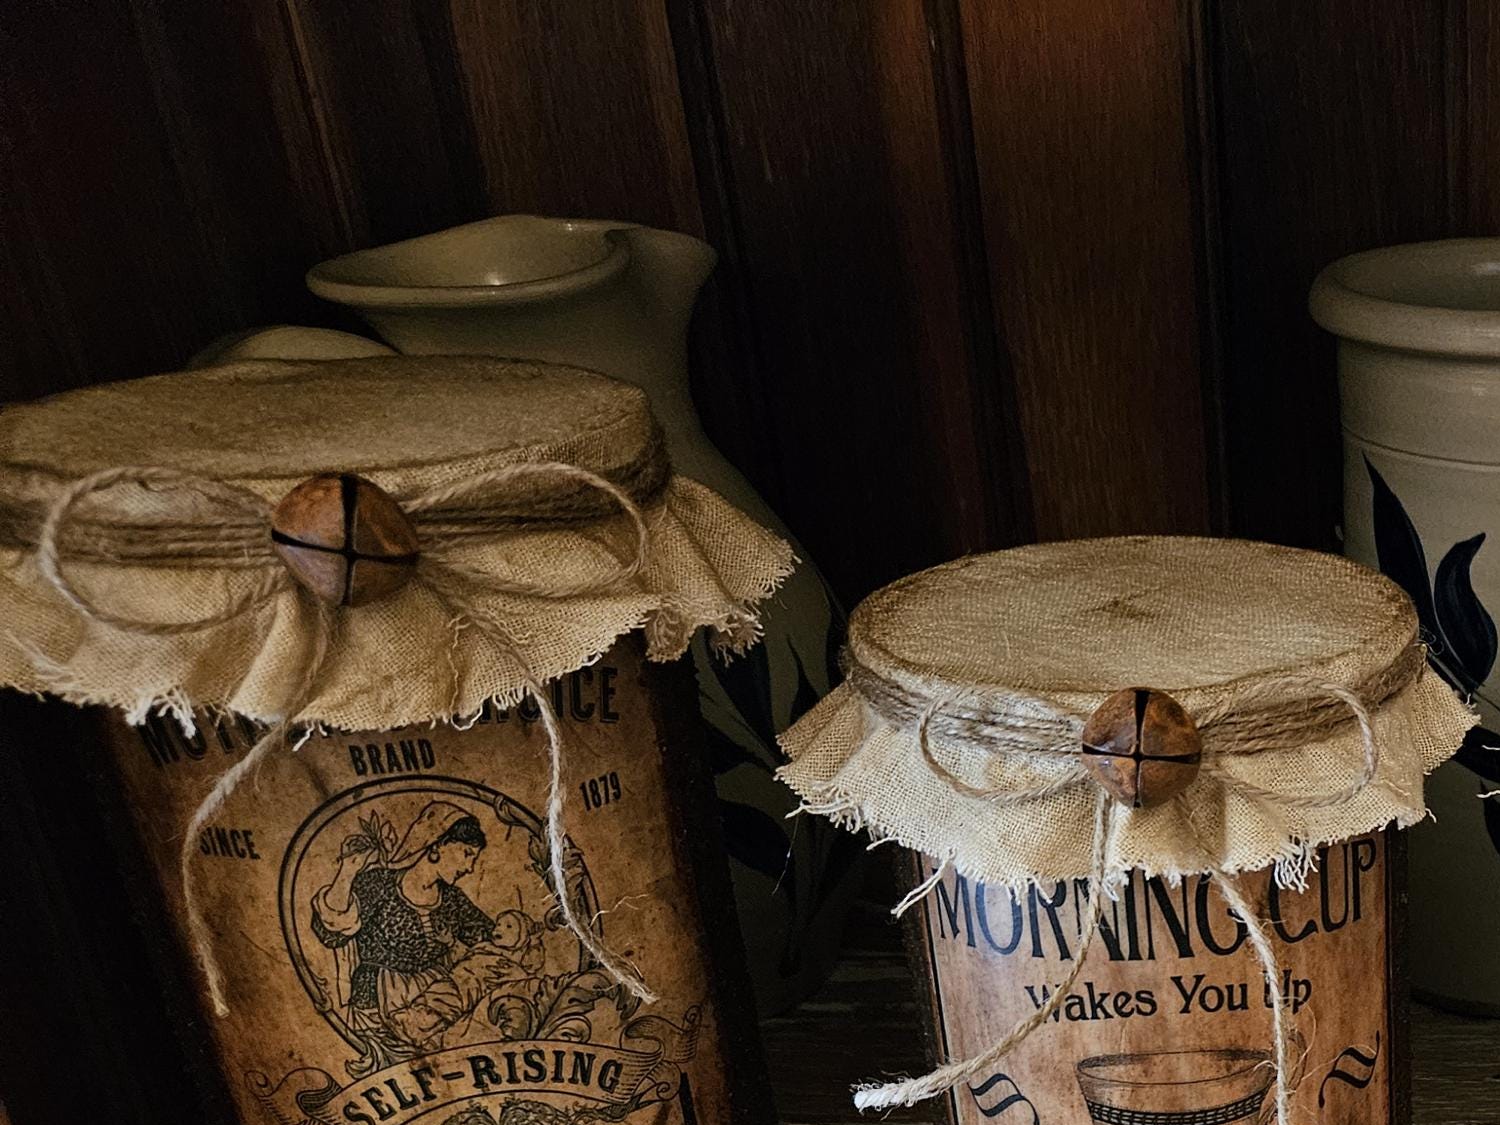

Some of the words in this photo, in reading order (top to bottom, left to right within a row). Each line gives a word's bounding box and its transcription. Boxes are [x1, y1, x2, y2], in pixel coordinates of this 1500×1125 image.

[349, 738, 436, 776] BRAND
[579, 771, 622, 812] 1879
[200, 826, 261, 860] SINCE
[932, 864, 1252, 961] MORNING
[1268, 838, 1378, 944] CUP
[1025, 981, 1157, 1022] Wakes
[1171, 974, 1248, 1014] You
[1263, 969, 1312, 1015] Up
